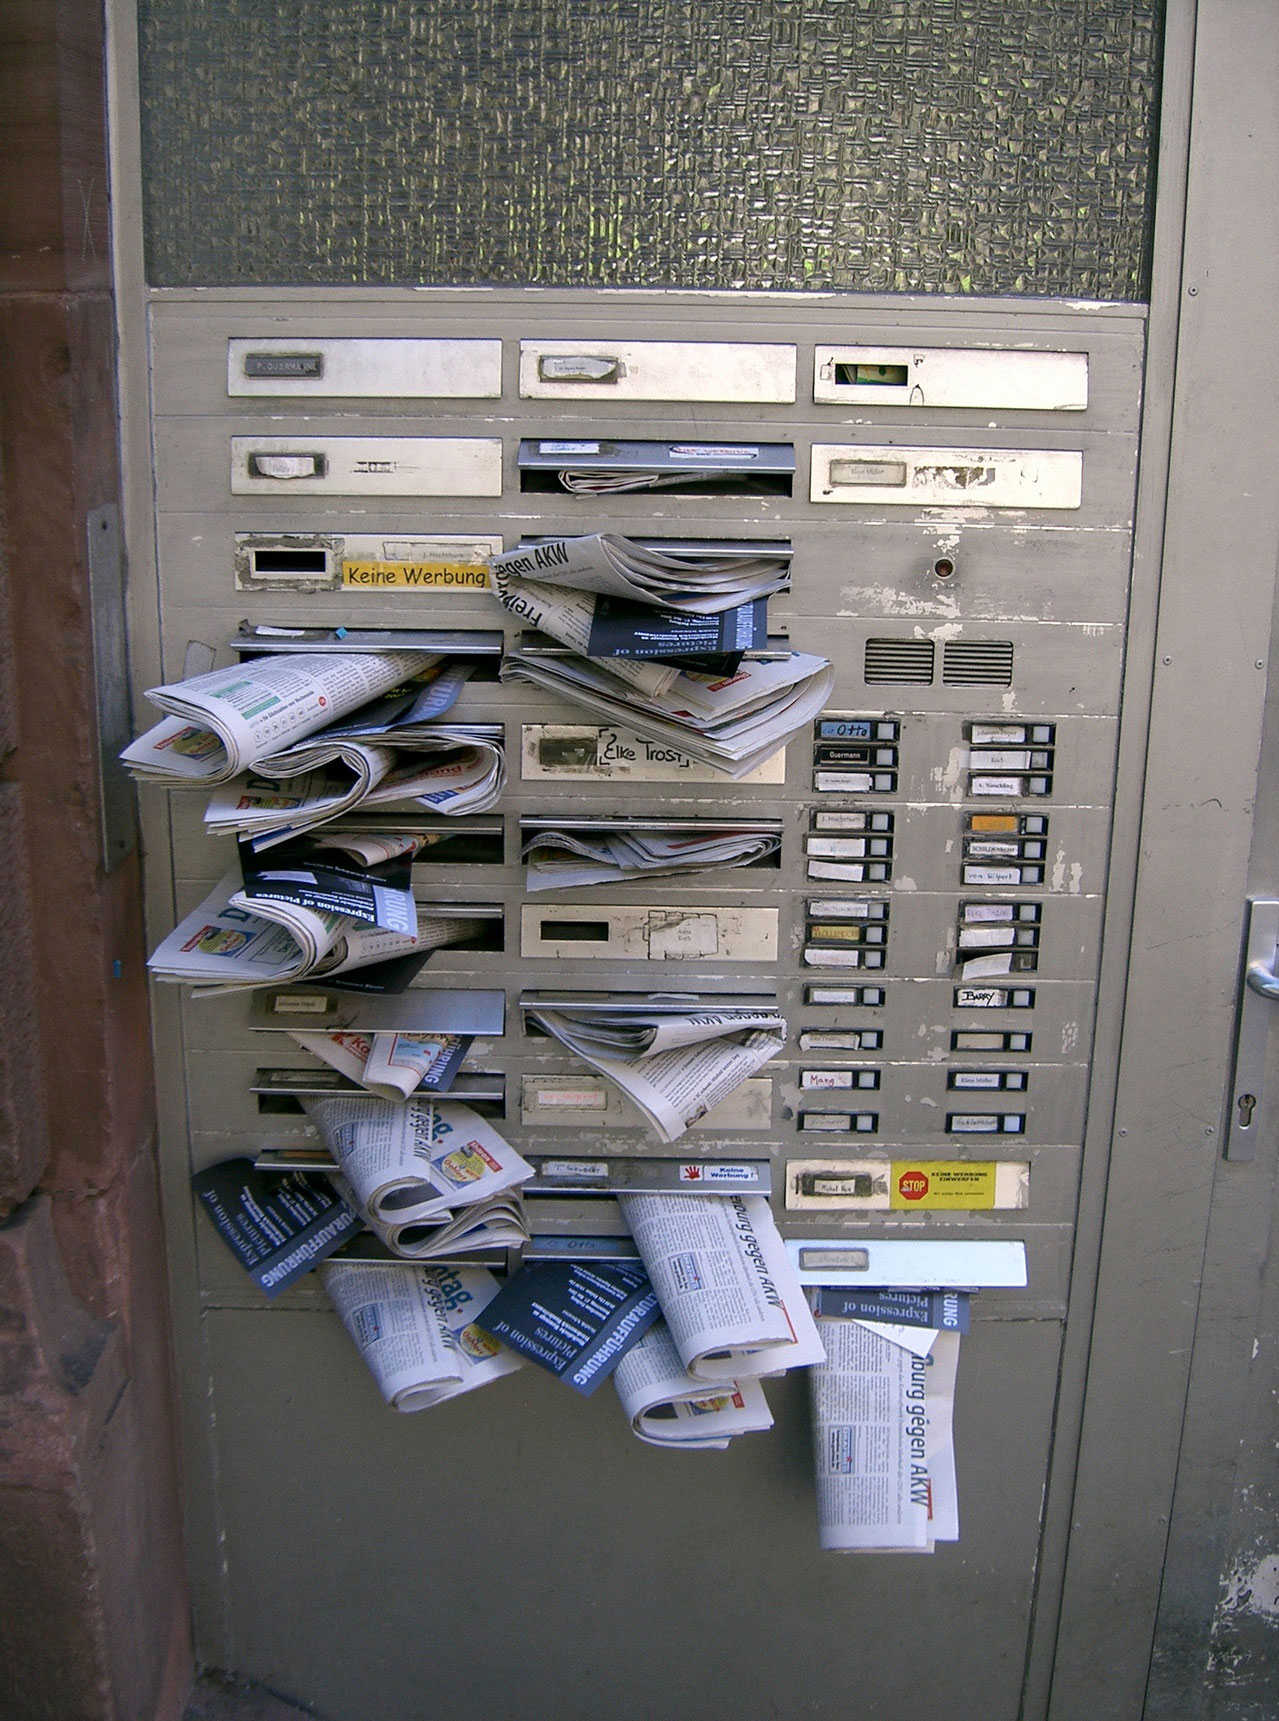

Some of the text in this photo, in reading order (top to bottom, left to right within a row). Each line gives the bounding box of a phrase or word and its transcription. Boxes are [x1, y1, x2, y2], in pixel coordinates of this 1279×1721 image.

[534, 541, 569, 569] AKW
[348, 568, 486, 588] Keine Werbung
[837, 724, 867, 736] Otto
[301, 899, 315, 909] of
[317, 901, 376, 922] Expression
[961, 991, 995, 1006] BARRY
[710, 1172, 749, 1180] Werbung
[902, 1181, 926, 1193] STOP
[739, 1234, 769, 1275] gegen
[759, 1276, 786, 1311] AKW
[842, 1301, 928, 1322] Expression of
[492, 1318, 568, 1373] Expression of
[533, 1324, 578, 1360] Pictures
[906, 1405, 926, 1459] gegen
[910, 1463, 929, 1507] AKW
